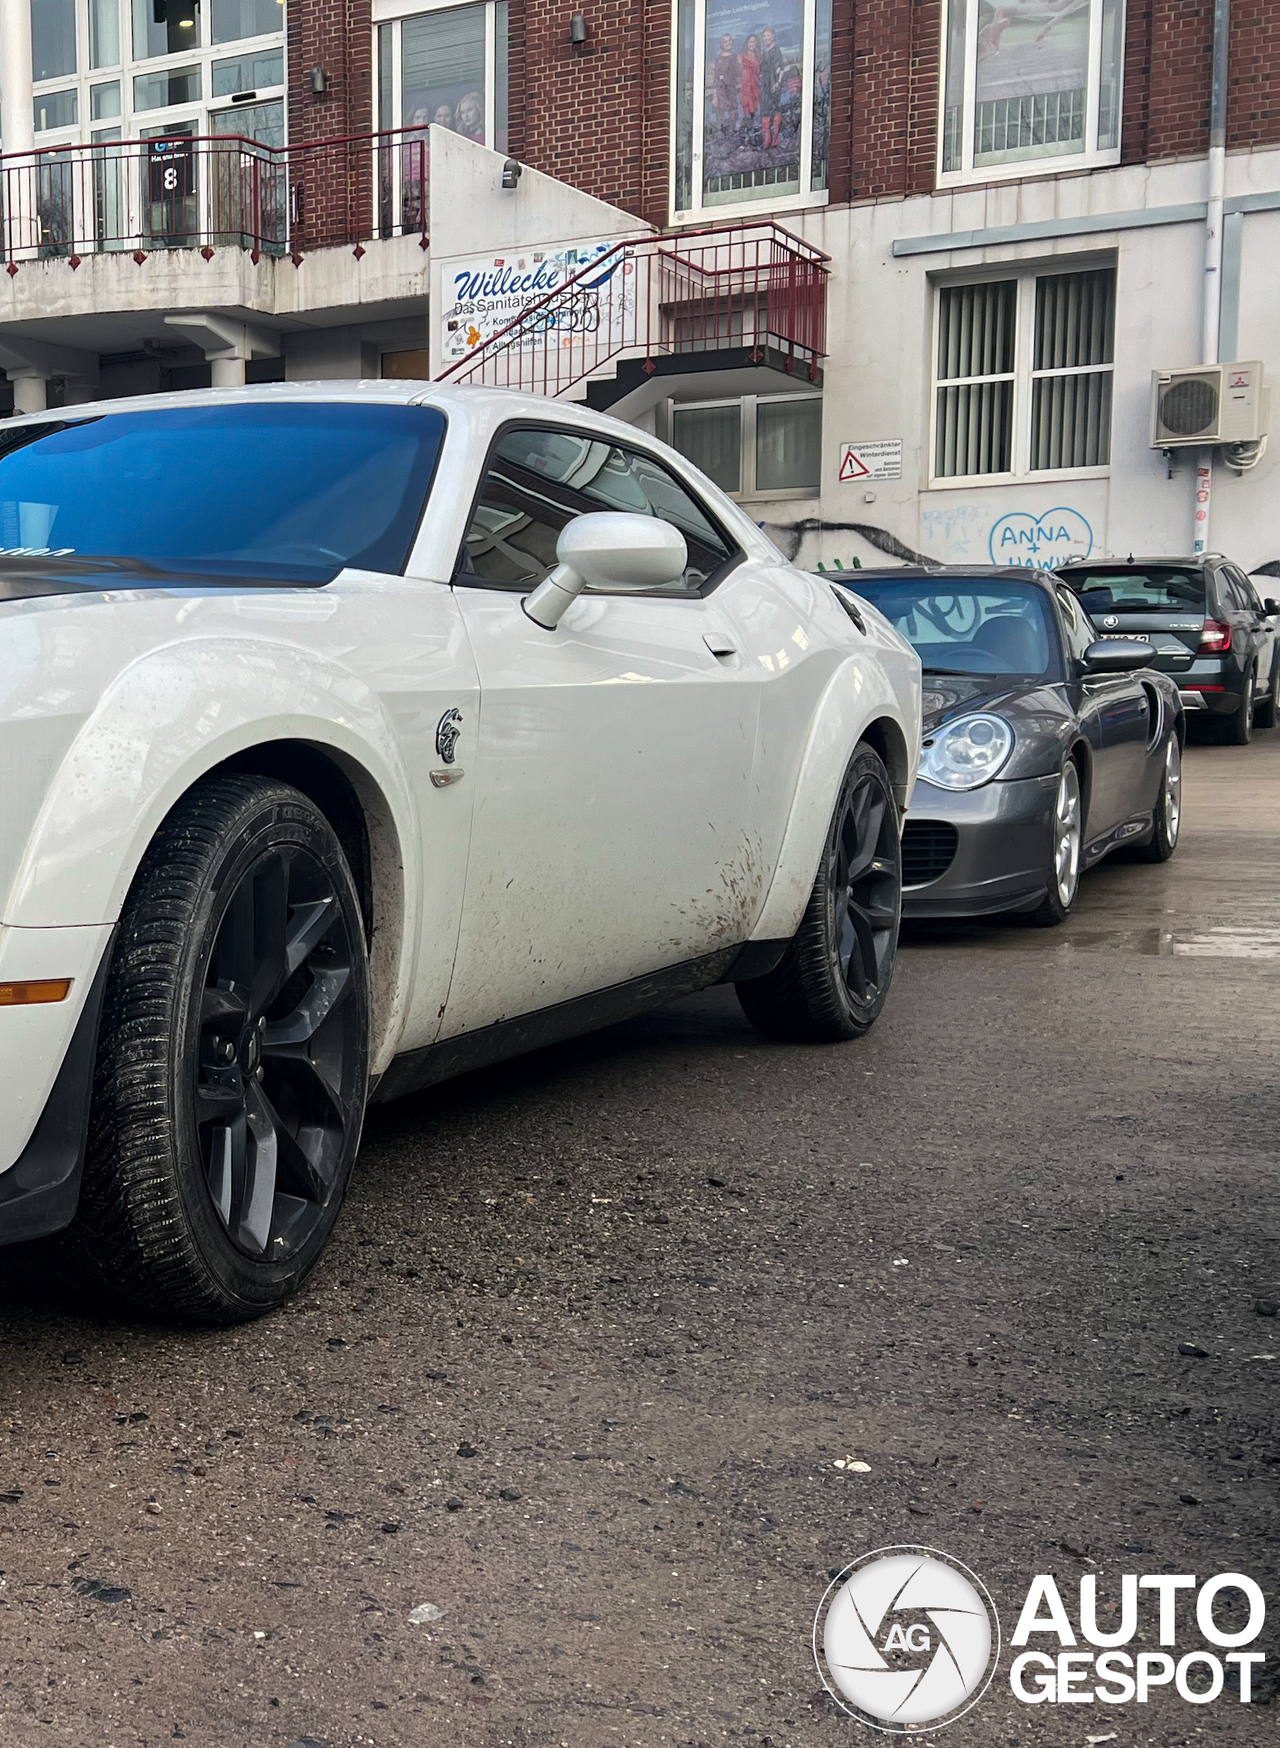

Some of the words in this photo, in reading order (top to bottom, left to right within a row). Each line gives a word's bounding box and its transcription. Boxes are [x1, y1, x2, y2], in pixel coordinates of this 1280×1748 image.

[164, 167, 178, 190] 8
[454, 260, 559, 300] Willecke
[848, 442, 901, 451] Eingeschränkter
[860, 450, 901, 458] Winterdienst
[1001, 526, 1071, 547] ANNA
